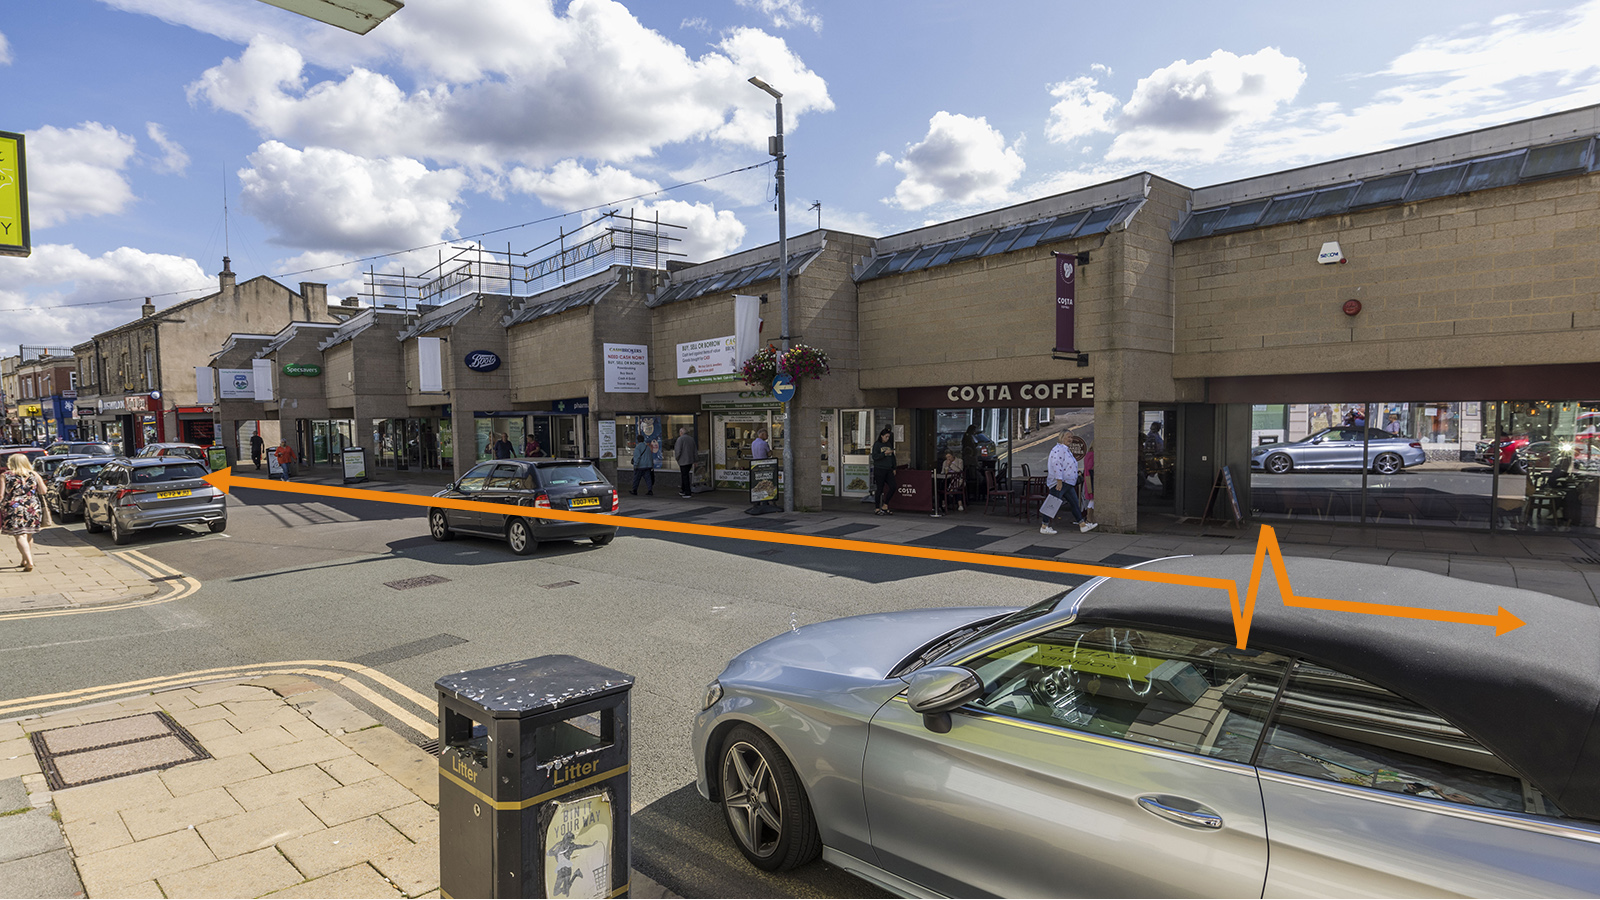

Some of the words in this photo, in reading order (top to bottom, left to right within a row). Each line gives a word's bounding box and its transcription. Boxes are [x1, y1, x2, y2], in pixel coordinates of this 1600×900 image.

[1057, 297, 1074, 306] COSTA
[704, 340, 720, 348] BORROW
[469, 353, 497, 368] Boots
[947, 385, 1012, 403] COSTA
[1020, 382, 1094, 400] COFFE
[452, 755, 478, 784] Litter
[553, 758, 600, 785] Litter
[563, 806, 581, 823] BIN
[582, 801, 592, 814] IT
[554, 818, 580, 838] YOUR
[582, 810, 601, 828] WAY
